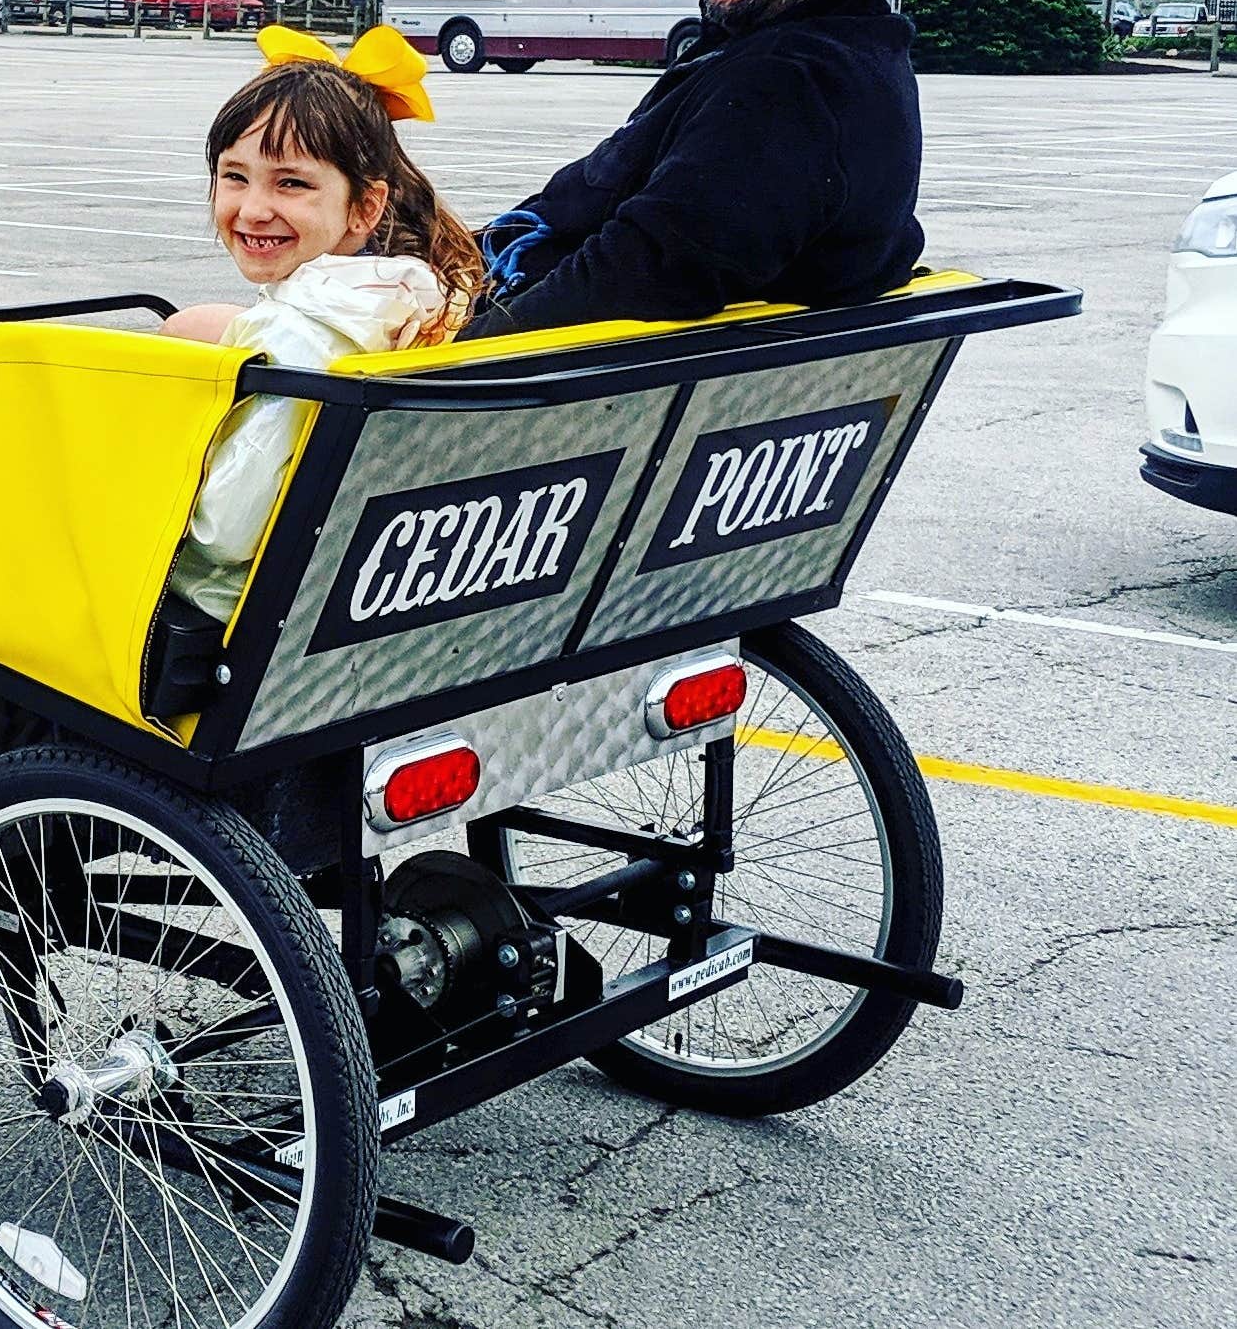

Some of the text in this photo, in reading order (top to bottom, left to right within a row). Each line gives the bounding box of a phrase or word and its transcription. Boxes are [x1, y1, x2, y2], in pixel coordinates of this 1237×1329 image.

[350, 420, 870, 622] CEDAR POINT
[671, 948, 751, 992] www.pedicab.com
[396, 1098, 414, 1118] Inc.
